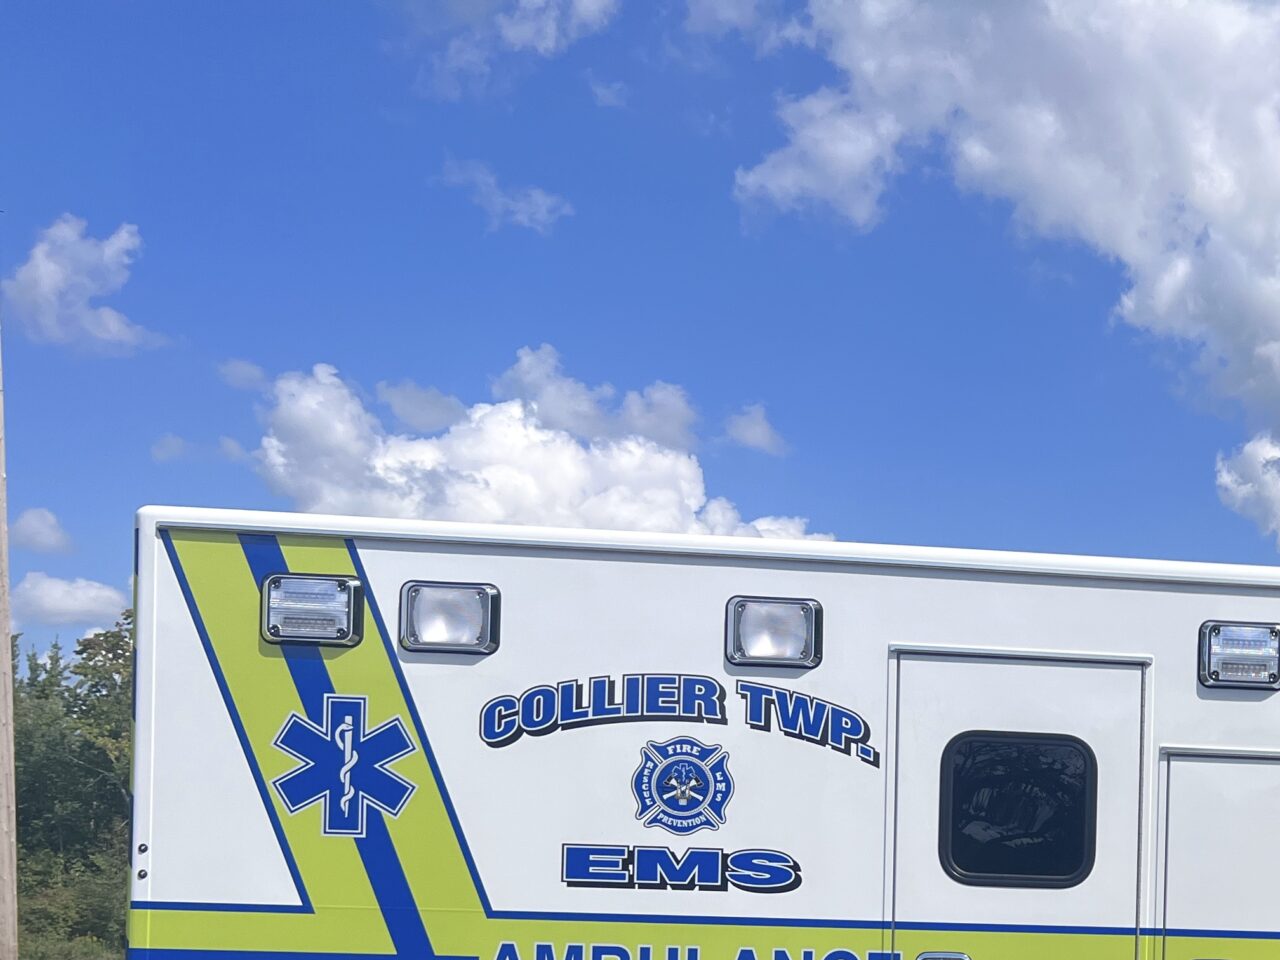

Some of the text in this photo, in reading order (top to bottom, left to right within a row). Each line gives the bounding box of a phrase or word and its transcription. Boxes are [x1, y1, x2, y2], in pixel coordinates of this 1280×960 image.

[479, 674, 880, 768] COLLIER TWP.
[667, 744, 701, 755] FIRE
[642, 761, 654, 805] RESCUE
[715, 772, 726, 802] EMS
[657, 813, 707, 828] PREVENTION
[561, 843, 802, 893] EMS
